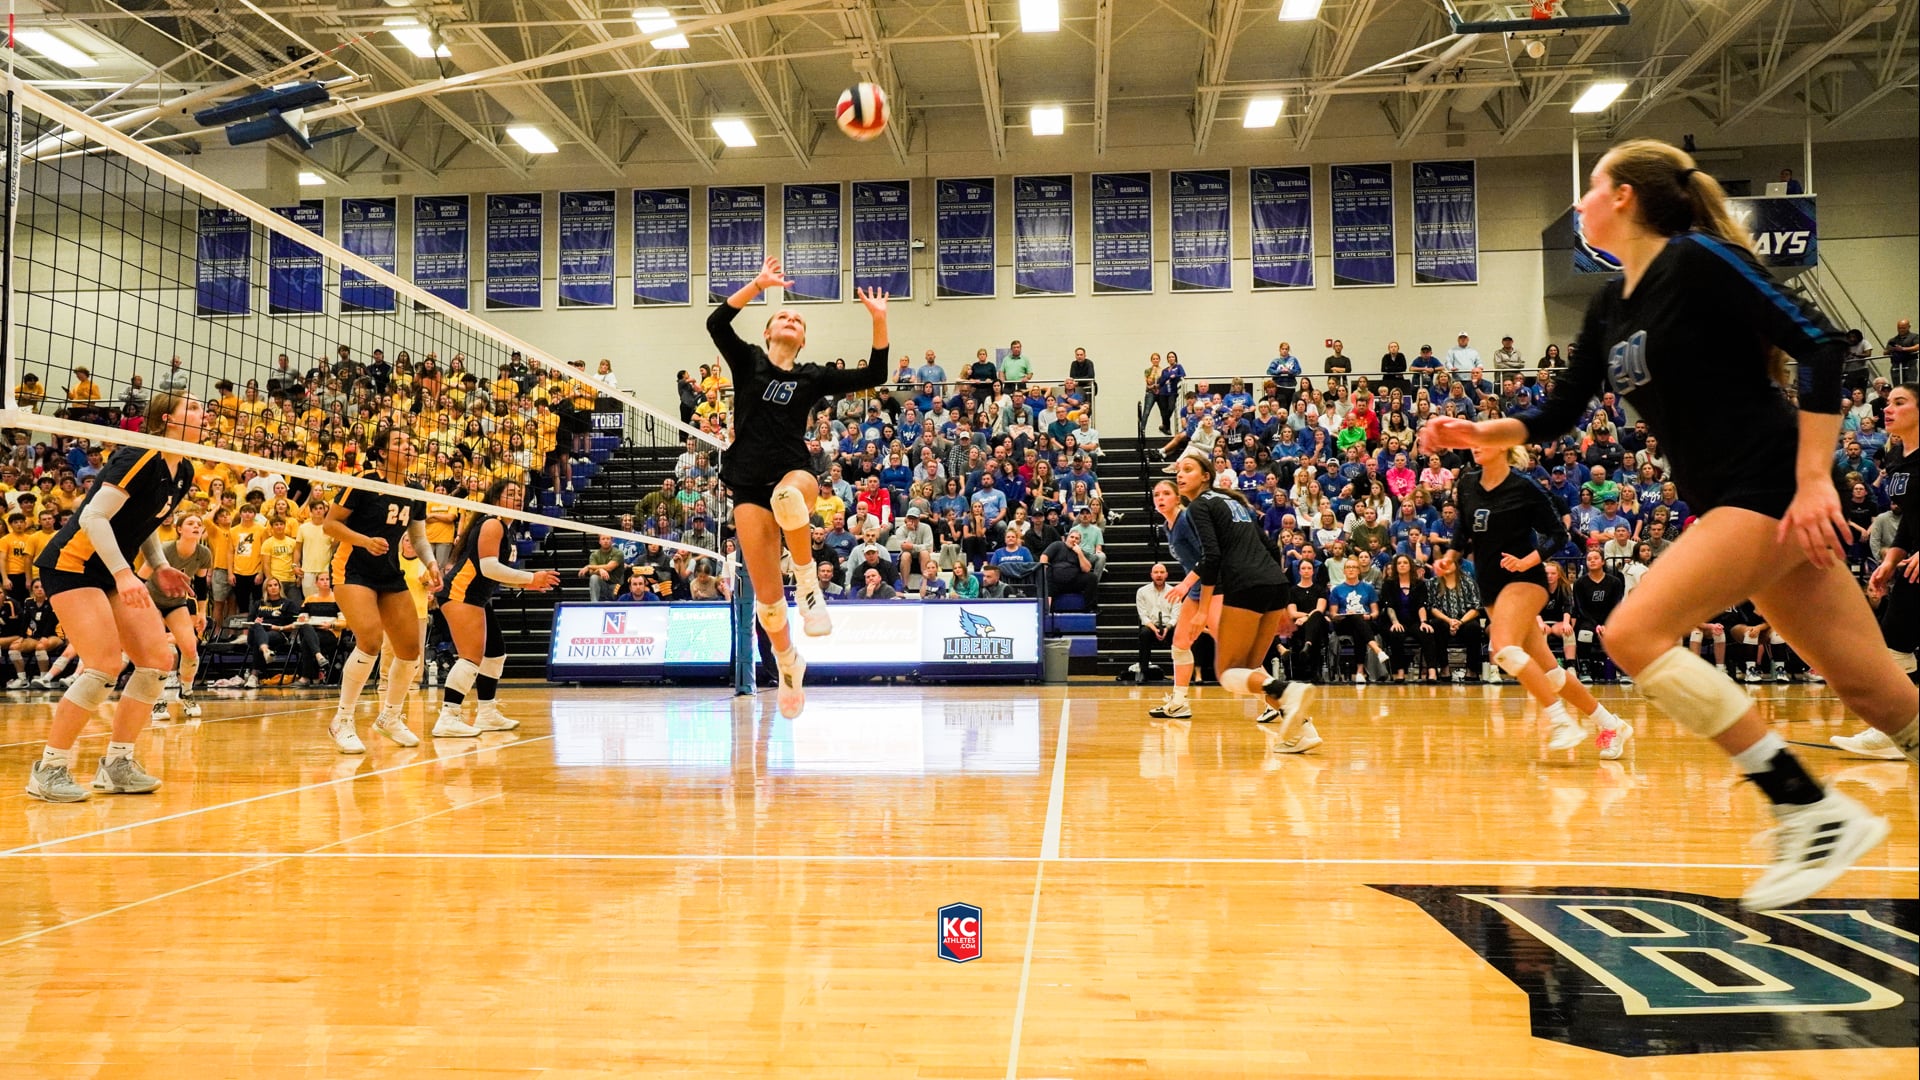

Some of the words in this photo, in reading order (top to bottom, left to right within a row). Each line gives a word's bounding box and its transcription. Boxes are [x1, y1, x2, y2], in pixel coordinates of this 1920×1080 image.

[1748, 231, 1811, 255] AYS
[762, 379, 798, 405] 16
[1889, 471, 1911, 497] 18
[386, 503, 411, 526] 24
[1472, 508, 1491, 533] 3
[568, 646, 620, 660] INJURY
[624, 646, 655, 658] LAW
[946, 638, 1012, 655] LIBERTY
